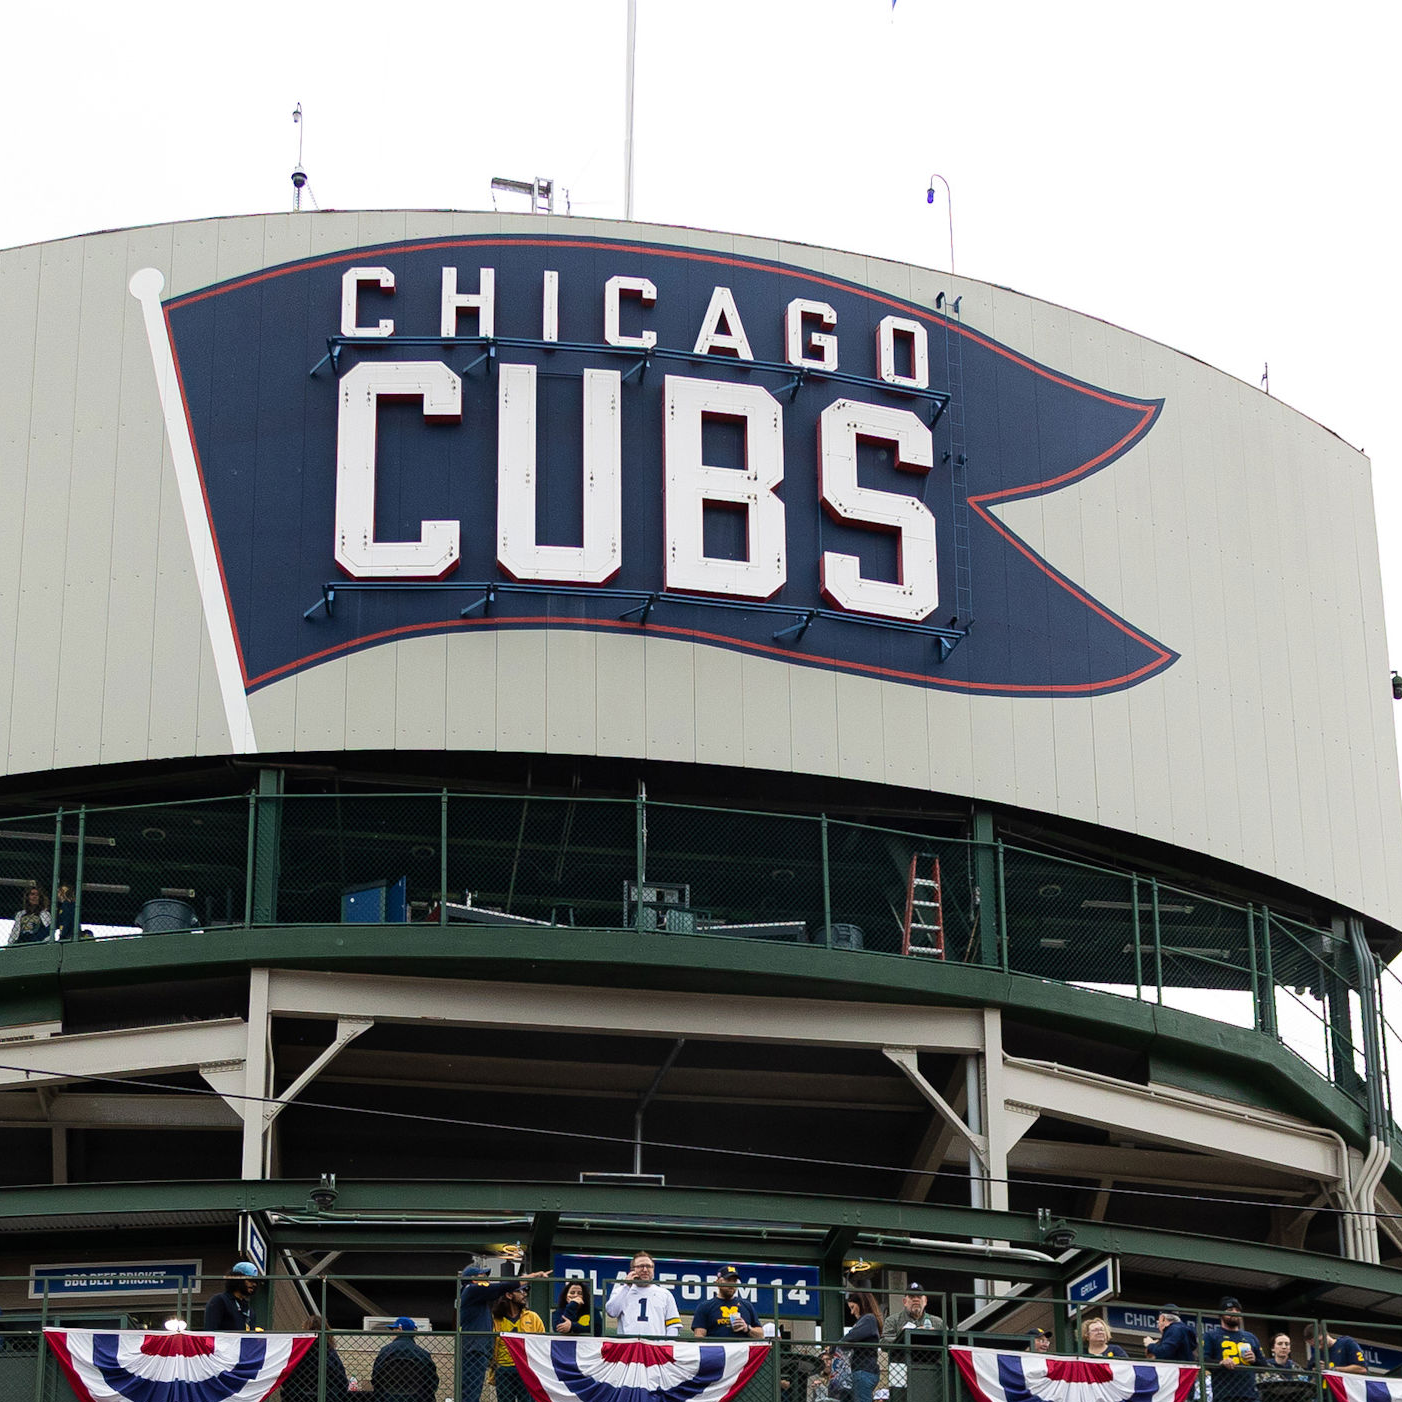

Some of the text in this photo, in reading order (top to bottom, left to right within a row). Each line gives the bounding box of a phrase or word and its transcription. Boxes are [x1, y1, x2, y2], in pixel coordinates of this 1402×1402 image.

[340, 266, 930, 390] CHICAGO
[333, 361, 939, 620] CUBS
[637, 1297, 649, 1322] 1
[770, 1278, 810, 1305] 14
